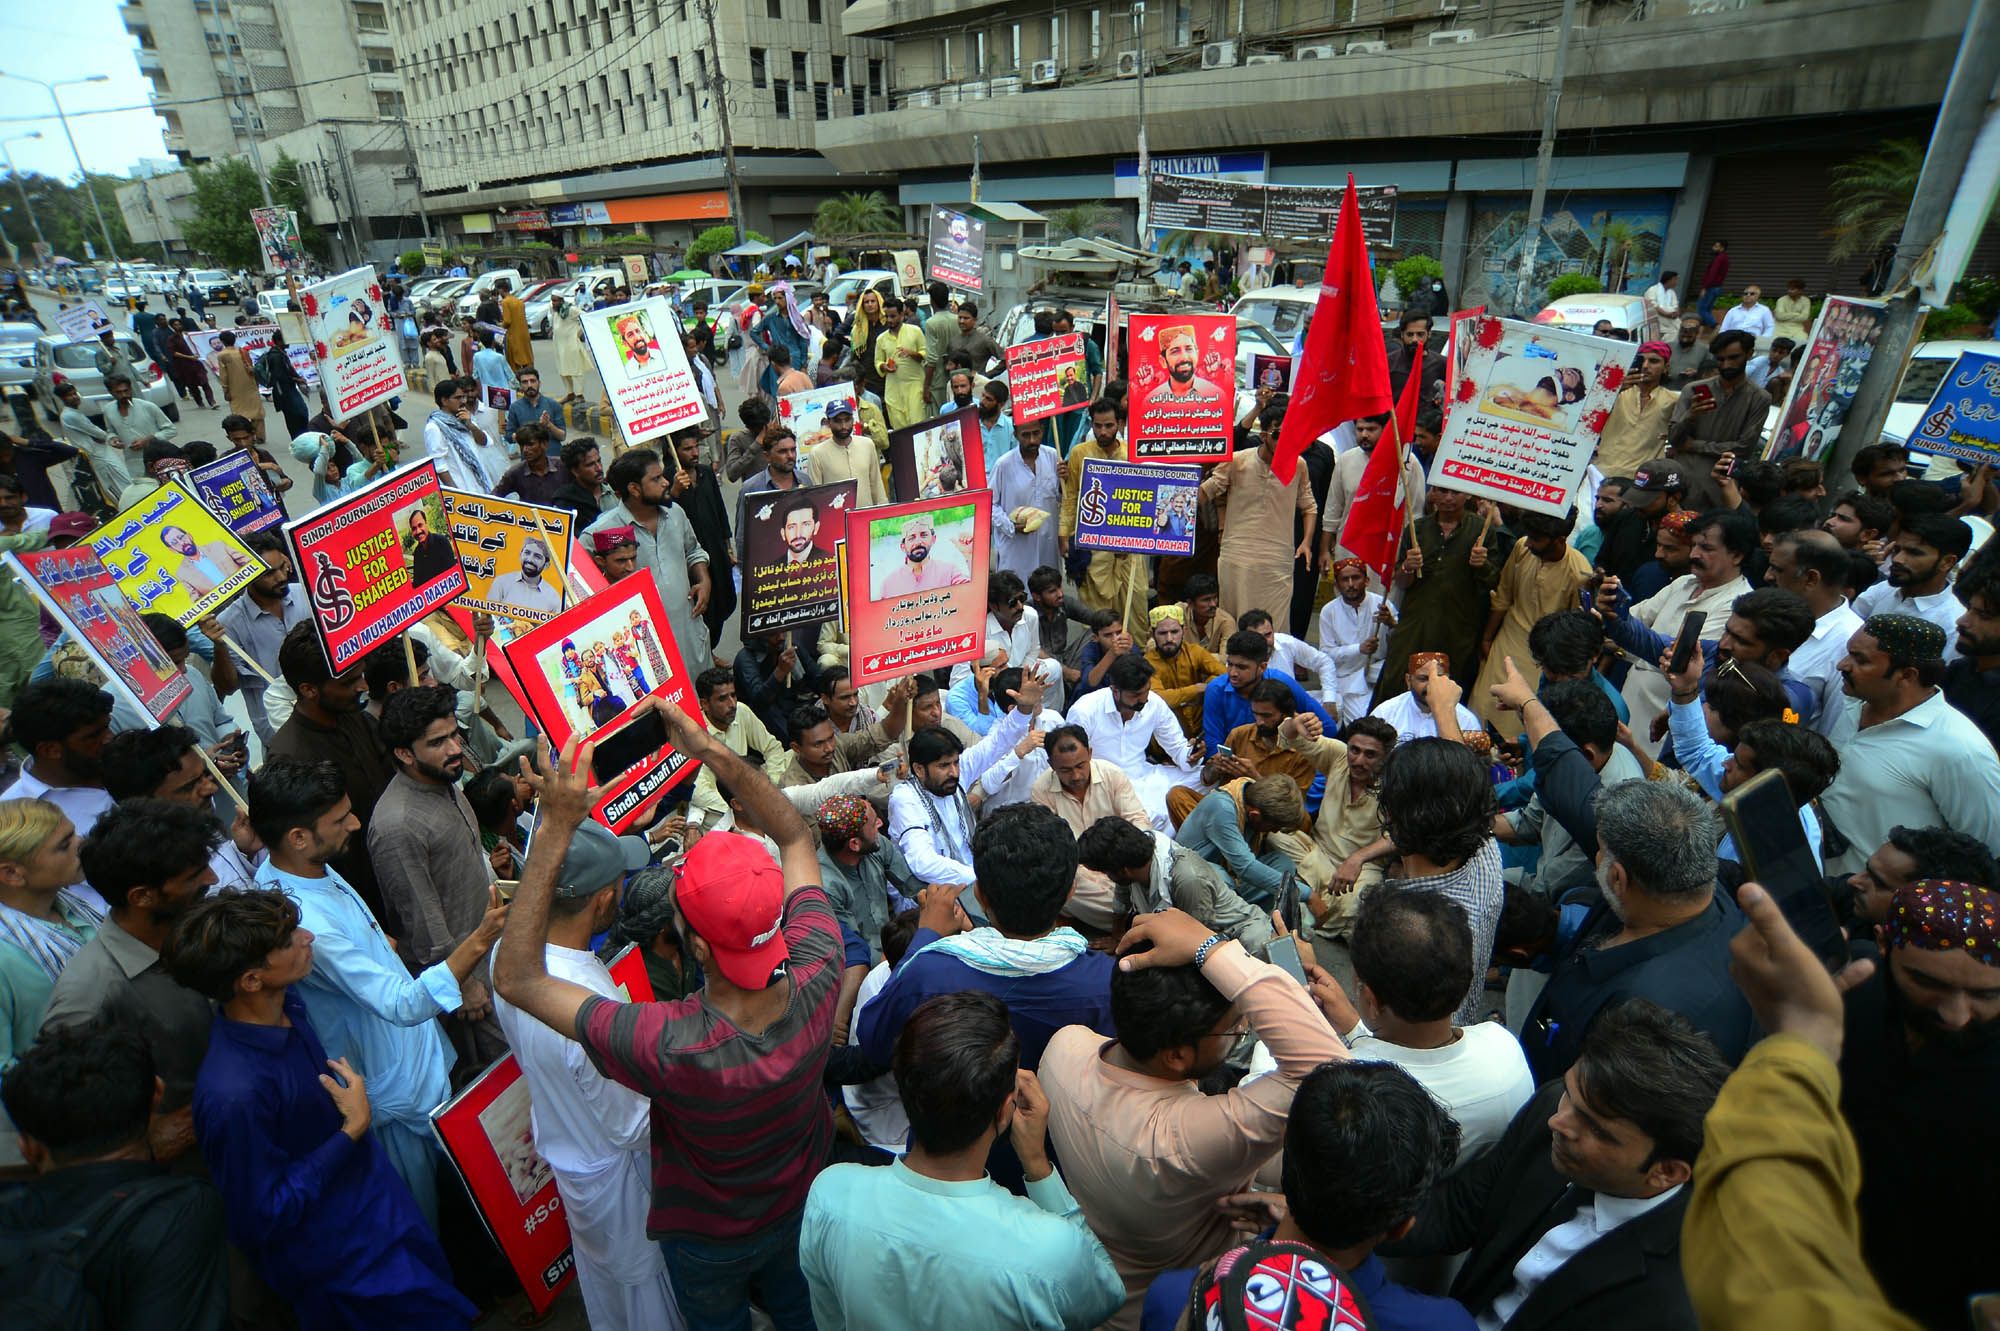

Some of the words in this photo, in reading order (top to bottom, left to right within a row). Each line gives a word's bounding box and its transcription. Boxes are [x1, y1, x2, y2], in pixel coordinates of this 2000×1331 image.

[1151, 157, 1220, 174] PRINCETON
[1913, 438, 1946, 451] SINDH
[1087, 465, 1112, 474] SINDH
[1112, 467, 1164, 478] JOURNALISTS
[1165, 470, 1198, 480] COUNCIL
[221, 480, 246, 497] JUSTICE
[1112, 488, 1154, 502] JUSTICE
[231, 494, 244, 506] FOR
[1121, 502, 1141, 513] FOR
[230, 501, 255, 519] SHAHEED
[300, 523, 333, 548] SINDH
[335, 492, 397, 530] JOURNALISTS
[397, 472, 433, 500] COUNCIL
[1107, 514, 1153, 528] SHAHEED
[345, 529, 396, 569] JUSTICE
[1079, 534, 1098, 544] JAN
[1100, 535, 1155, 549] MUHAMMAD
[1156, 539, 1190, 551] MAHAR
[362, 556, 389, 582] FOR
[219, 564, 259, 595] COUNCIL
[353, 568, 408, 612] SHAHEED
[337, 636, 360, 662] JAN
[360, 596, 424, 647] MUHAMMAD
[425, 572, 462, 603] MAHAR
[606, 791, 639, 821] Sindh
[638, 763, 670, 796] Sahafi
[670, 752, 686, 770] Ith
